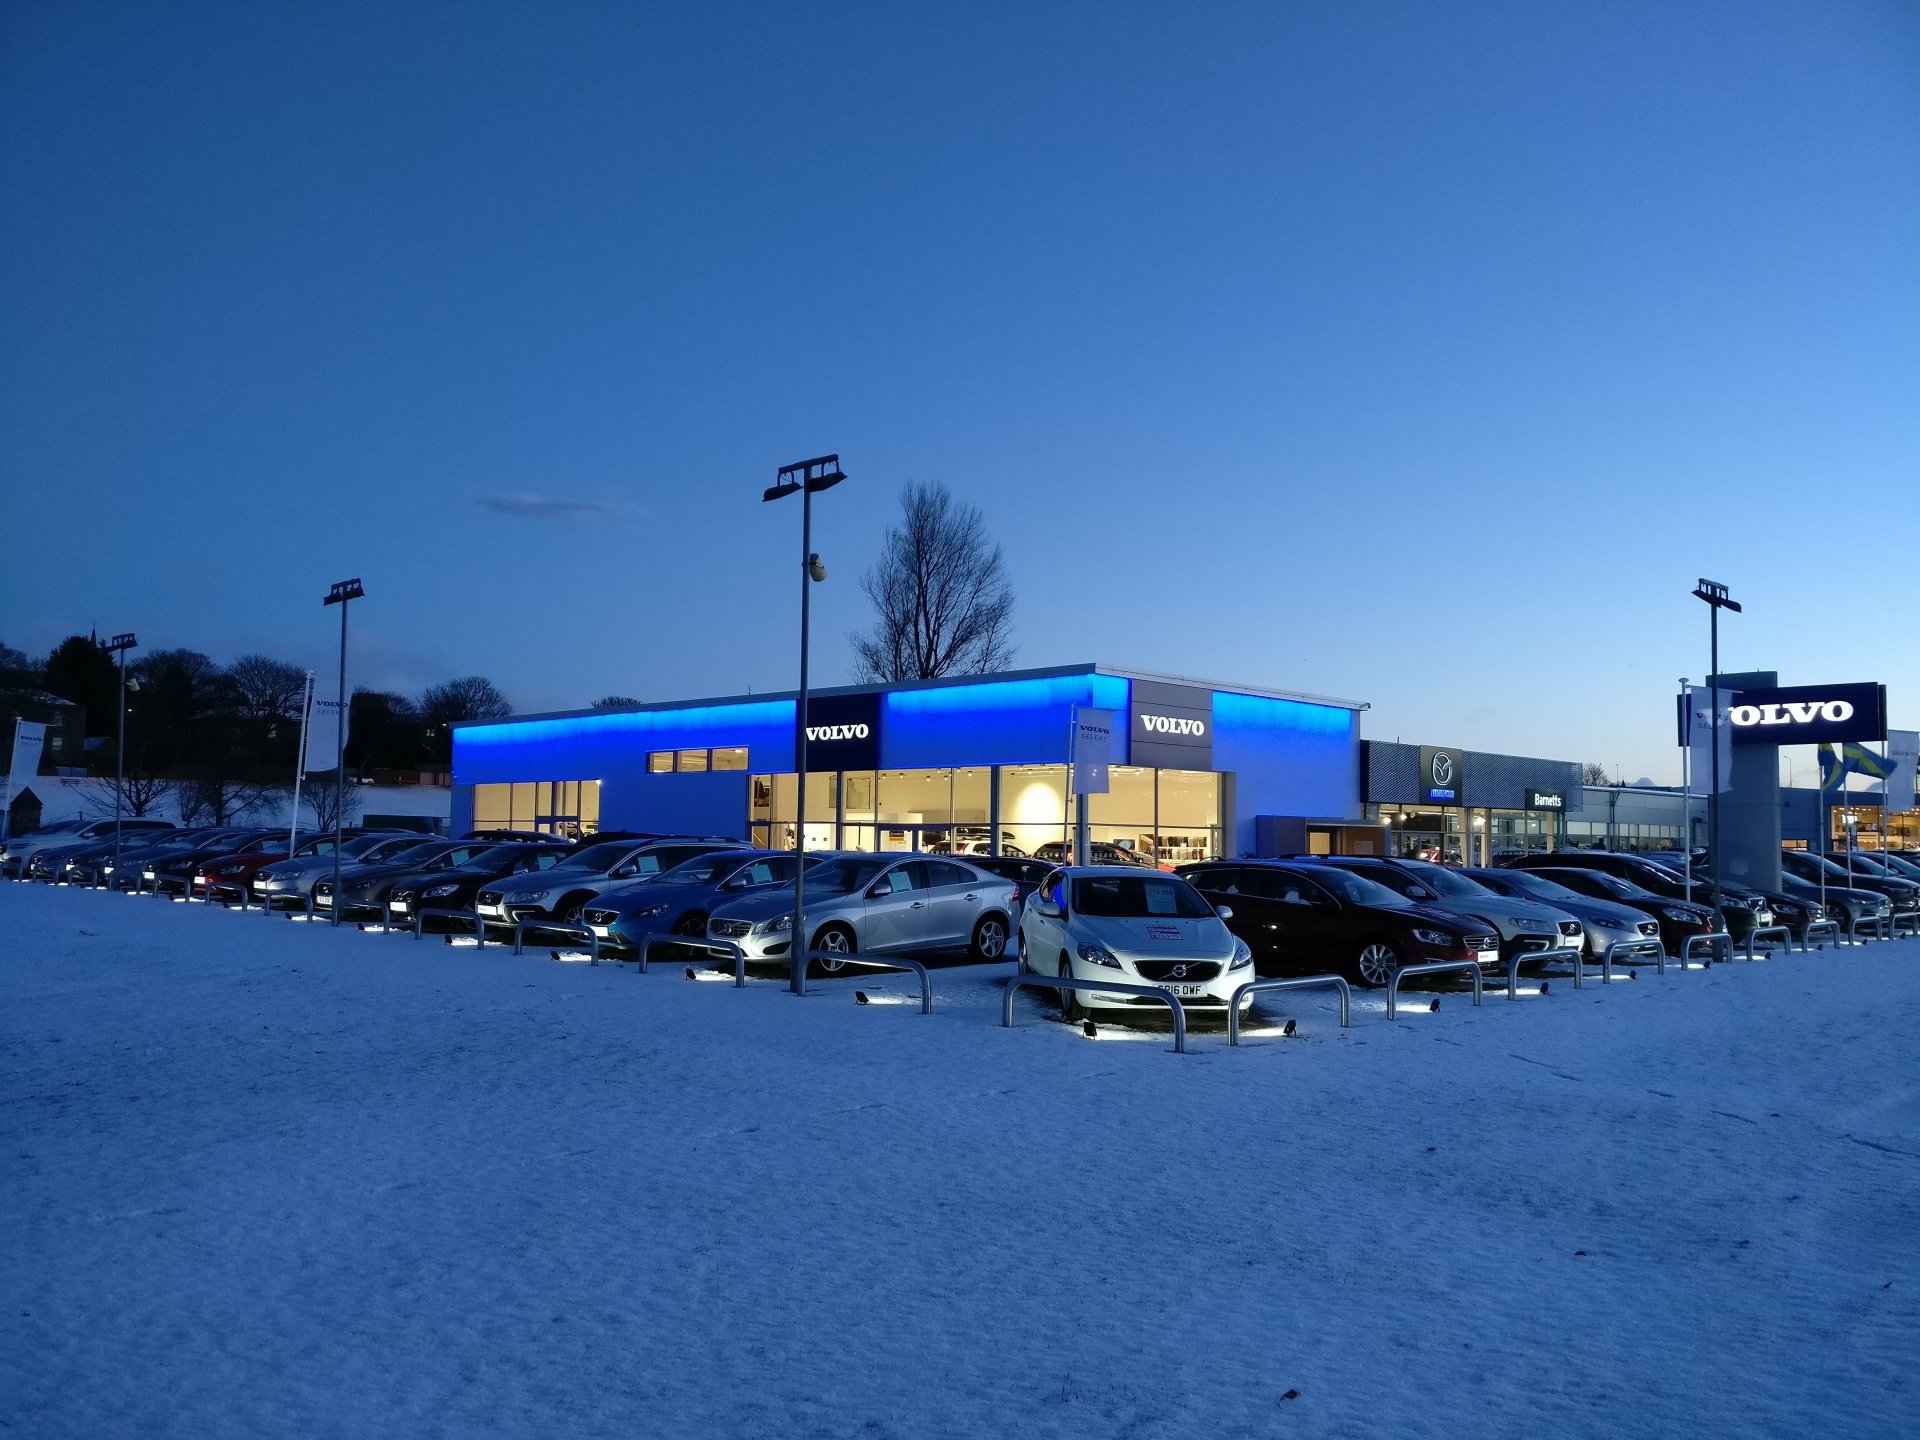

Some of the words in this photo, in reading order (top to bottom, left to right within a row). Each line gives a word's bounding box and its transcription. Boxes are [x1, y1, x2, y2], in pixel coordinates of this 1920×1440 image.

[1727, 700, 1854, 726] OLVO
[805, 723, 869, 741] VOLVO
[1080, 725, 1110, 735] VOLVO
[1140, 714, 1205, 736] VOLVO
[1534, 793, 1562, 807] Barnetts
